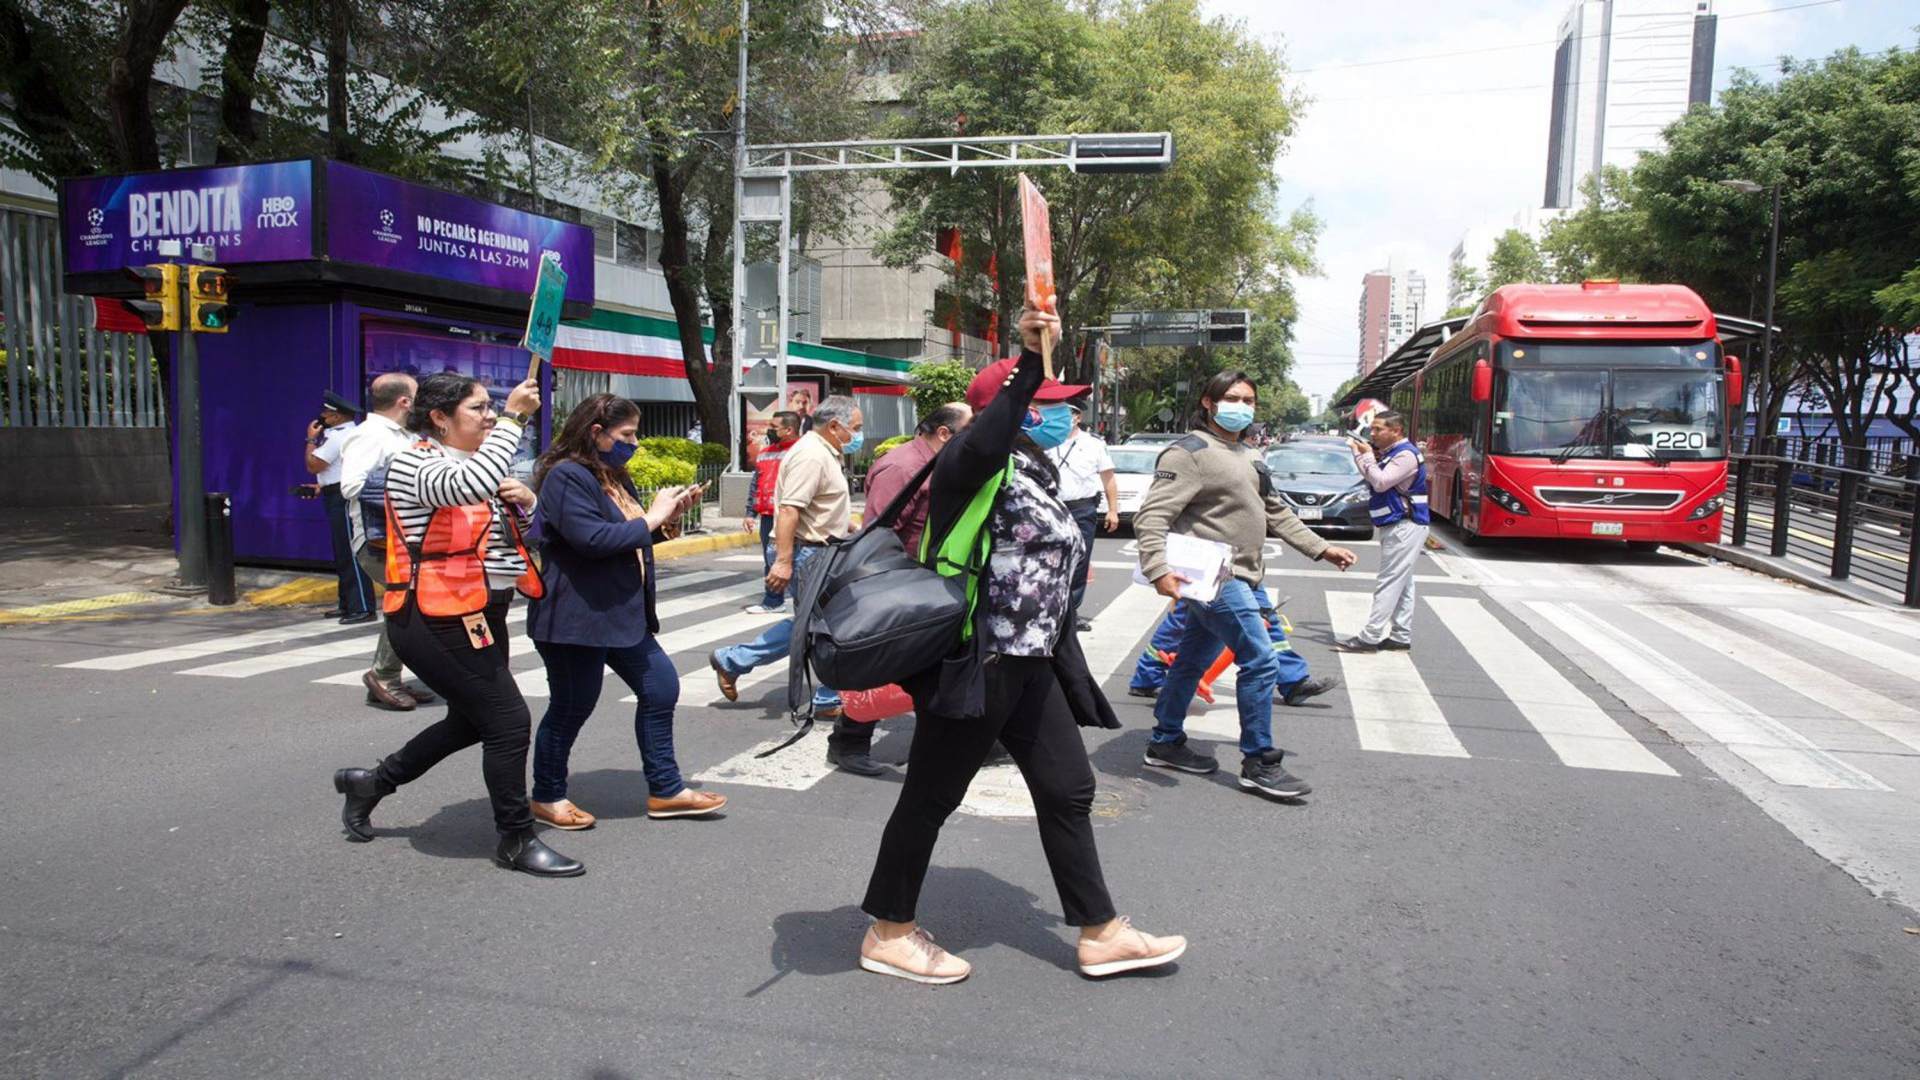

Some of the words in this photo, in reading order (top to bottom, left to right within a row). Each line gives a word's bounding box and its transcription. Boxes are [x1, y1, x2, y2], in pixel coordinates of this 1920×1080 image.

[129, 185, 242, 238] BENDITA
[262, 196, 295, 213] HBO
[257, 211, 298, 228] max
[131, 233, 242, 252] CHPIONS
[417, 214, 432, 234] NO
[433, 219, 477, 243] PECARÁS
[478, 228, 529, 254] AGENDANDO
[417, 237, 466, 258] JUNTAS
[469, 247, 478, 260] A
[480, 249, 502, 265] LAS
[505, 254, 529, 270] 2PM
[1656, 431, 1703, 449] 220
